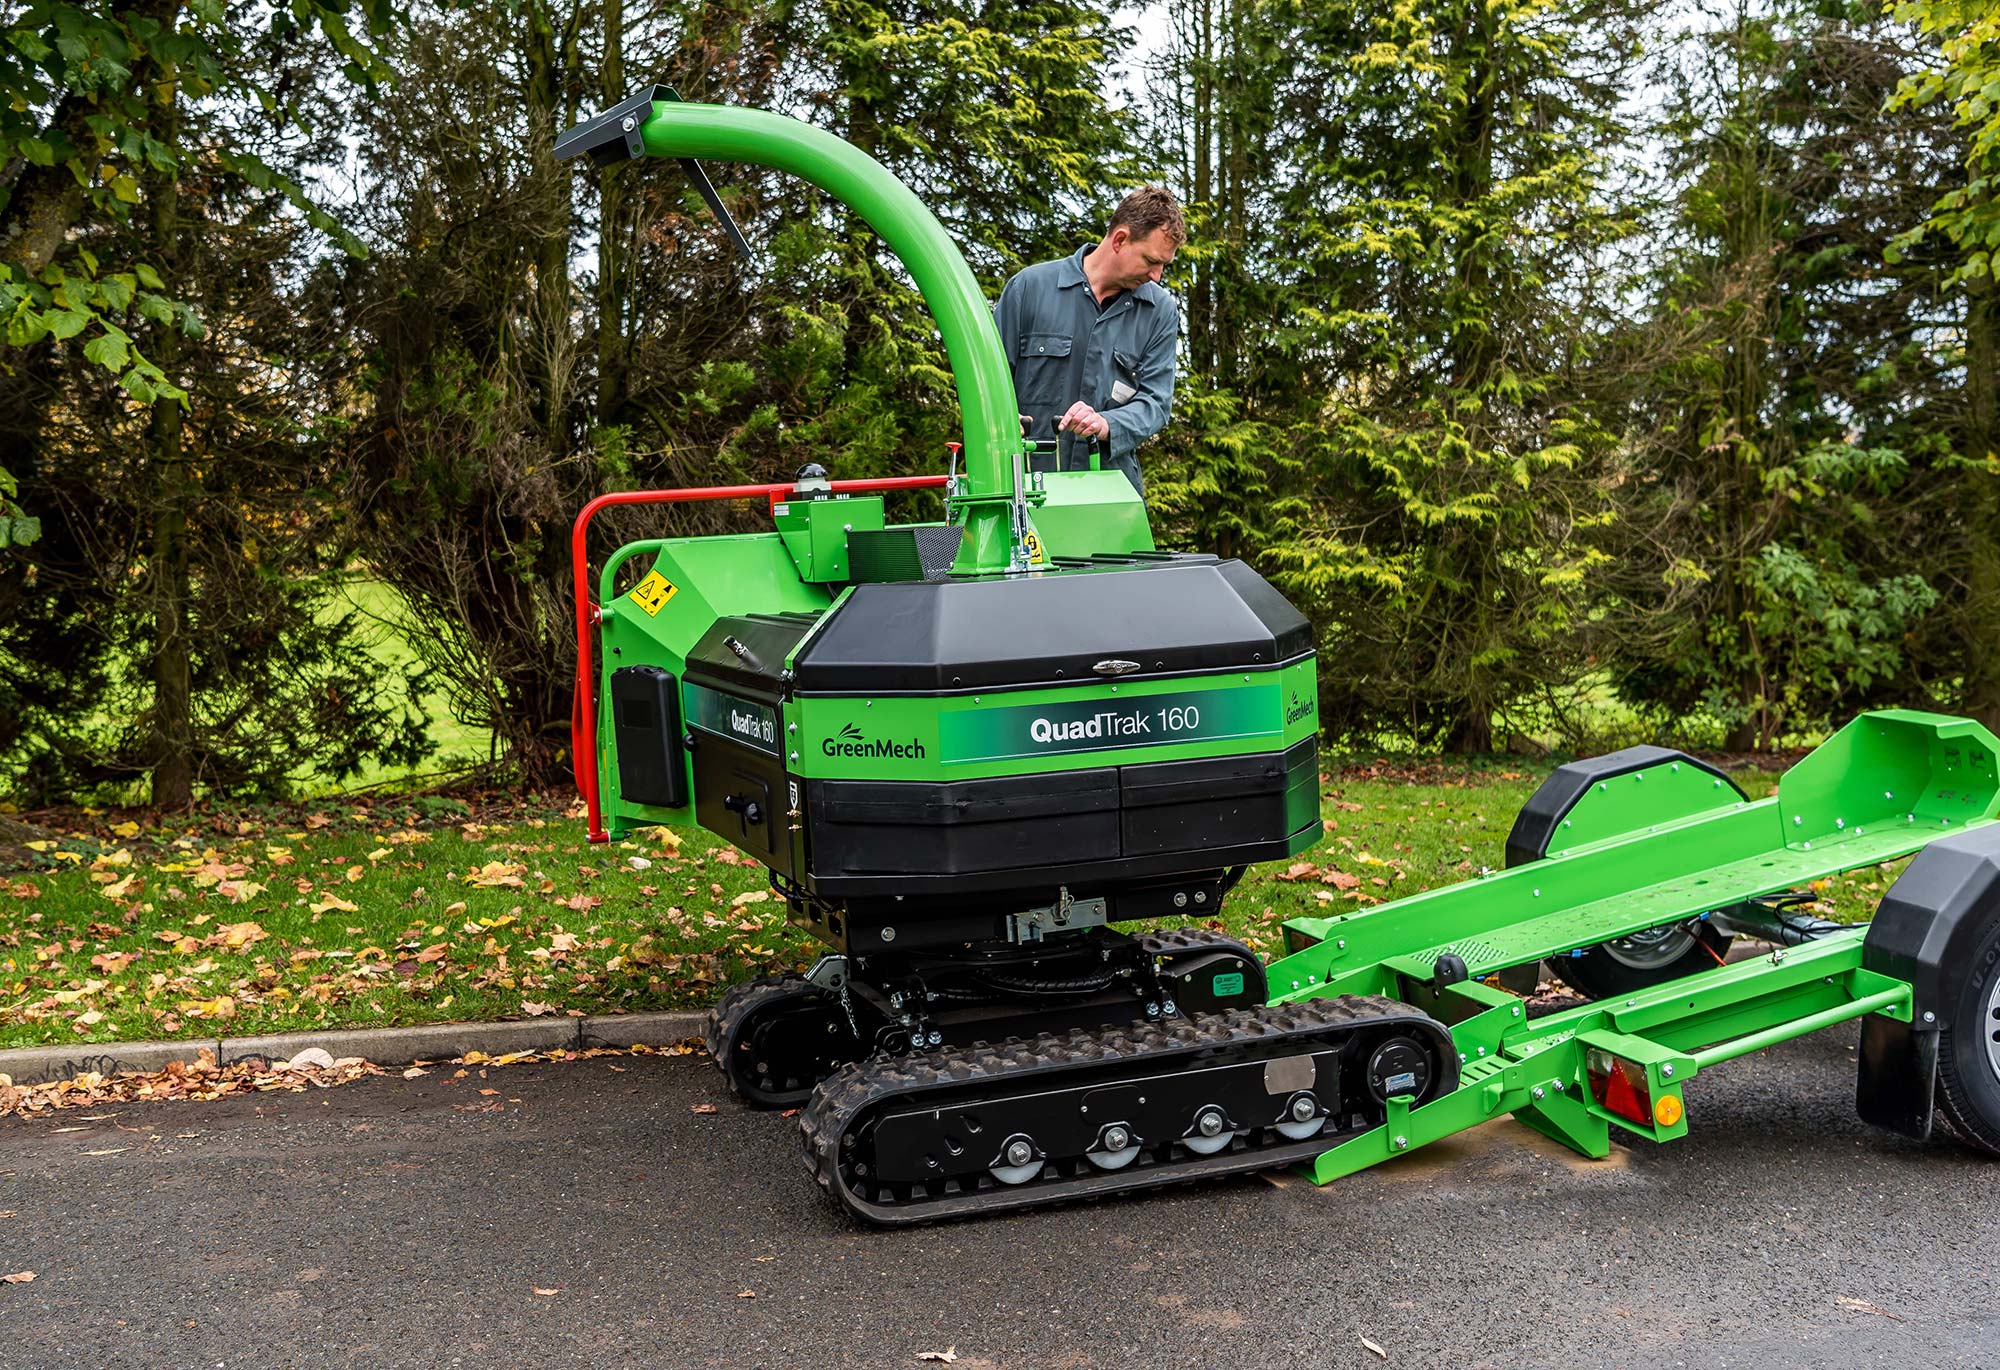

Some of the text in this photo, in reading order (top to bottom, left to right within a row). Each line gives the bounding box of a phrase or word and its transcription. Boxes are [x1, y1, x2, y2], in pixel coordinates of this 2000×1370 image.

[731, 709, 774, 743] QuadTrak 160
[1030, 705, 1200, 743] QuadTrak 160
[1286, 695, 1314, 726] GreenMech
[822, 738, 925, 759] GreenMech
